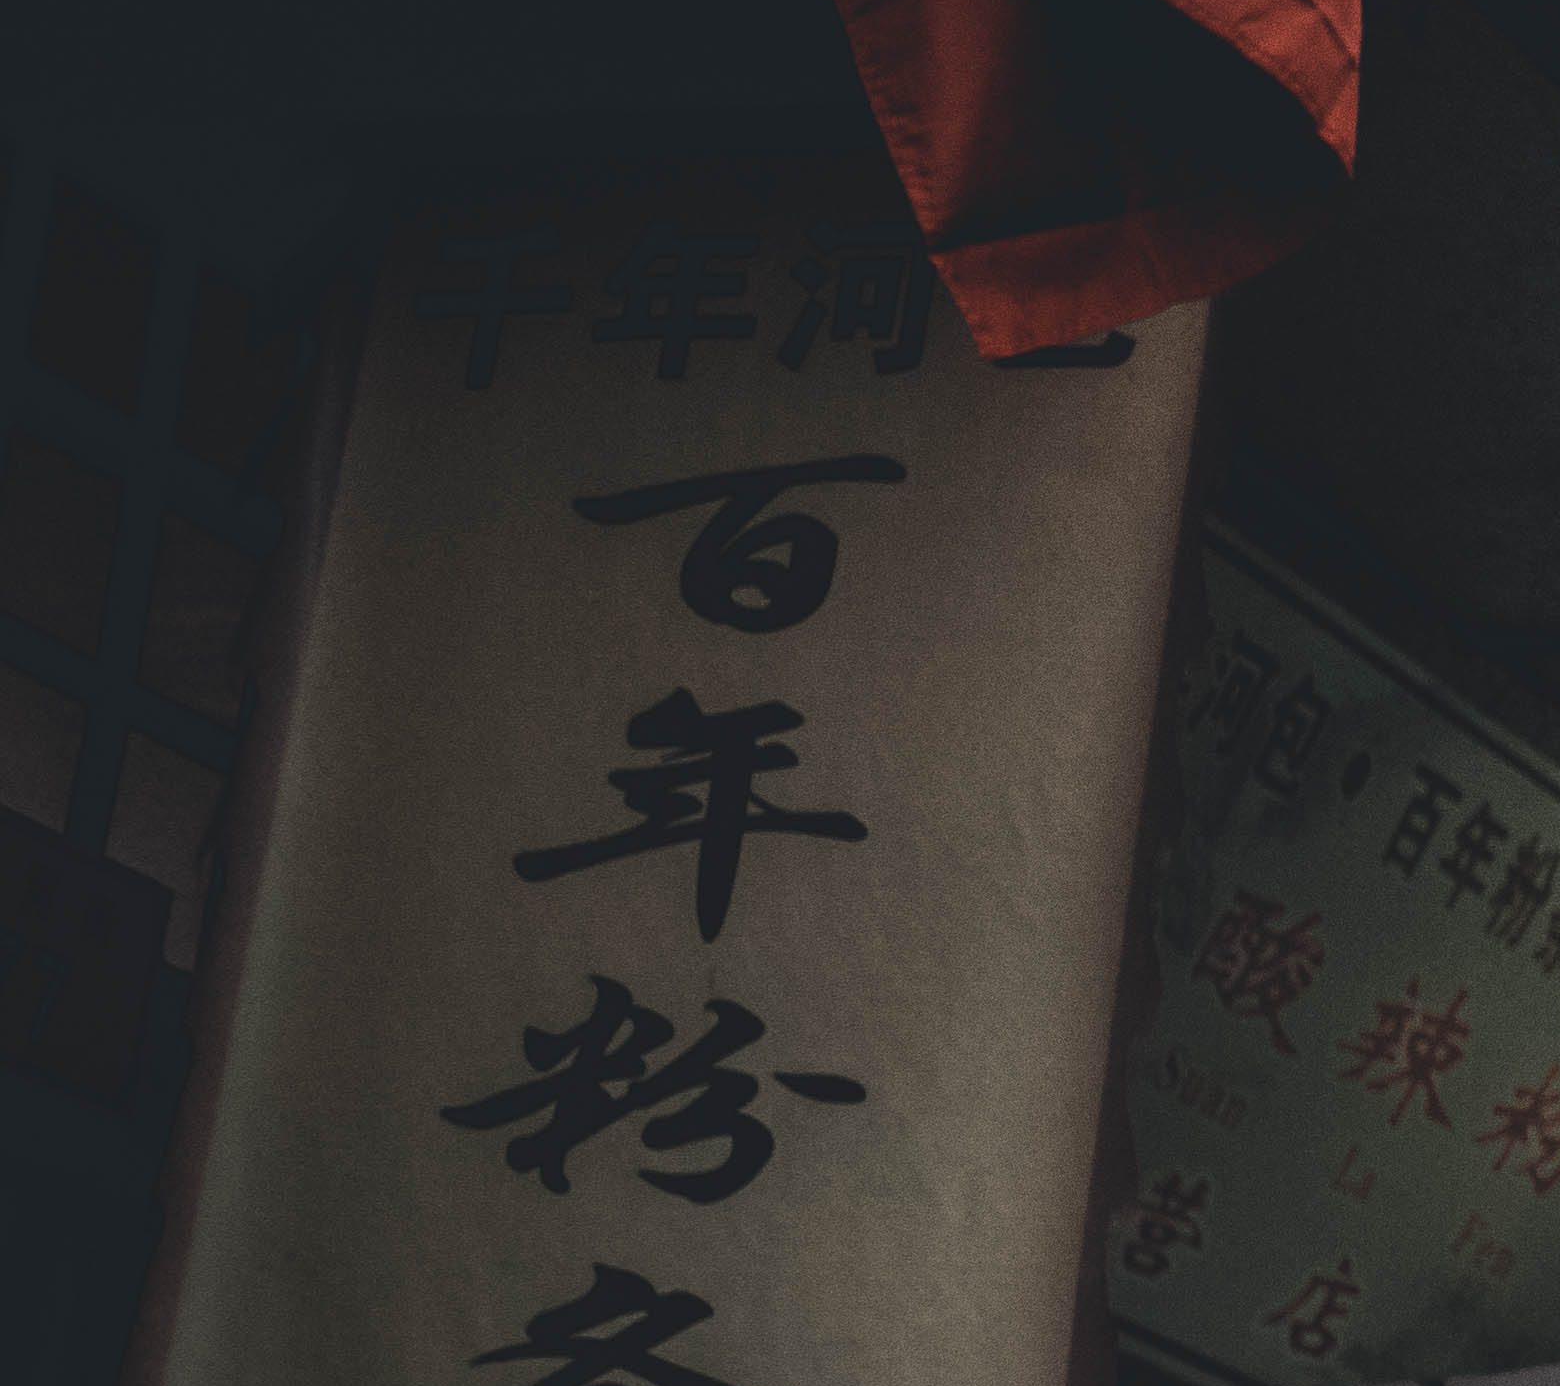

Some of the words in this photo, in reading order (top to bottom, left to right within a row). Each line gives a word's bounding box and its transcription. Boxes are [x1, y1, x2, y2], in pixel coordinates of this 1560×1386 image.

[411, 223, 1136, 392] 千年河
[1331, 1144, 1378, 1205] La
[1449, 1212, 1519, 1279] Fen
